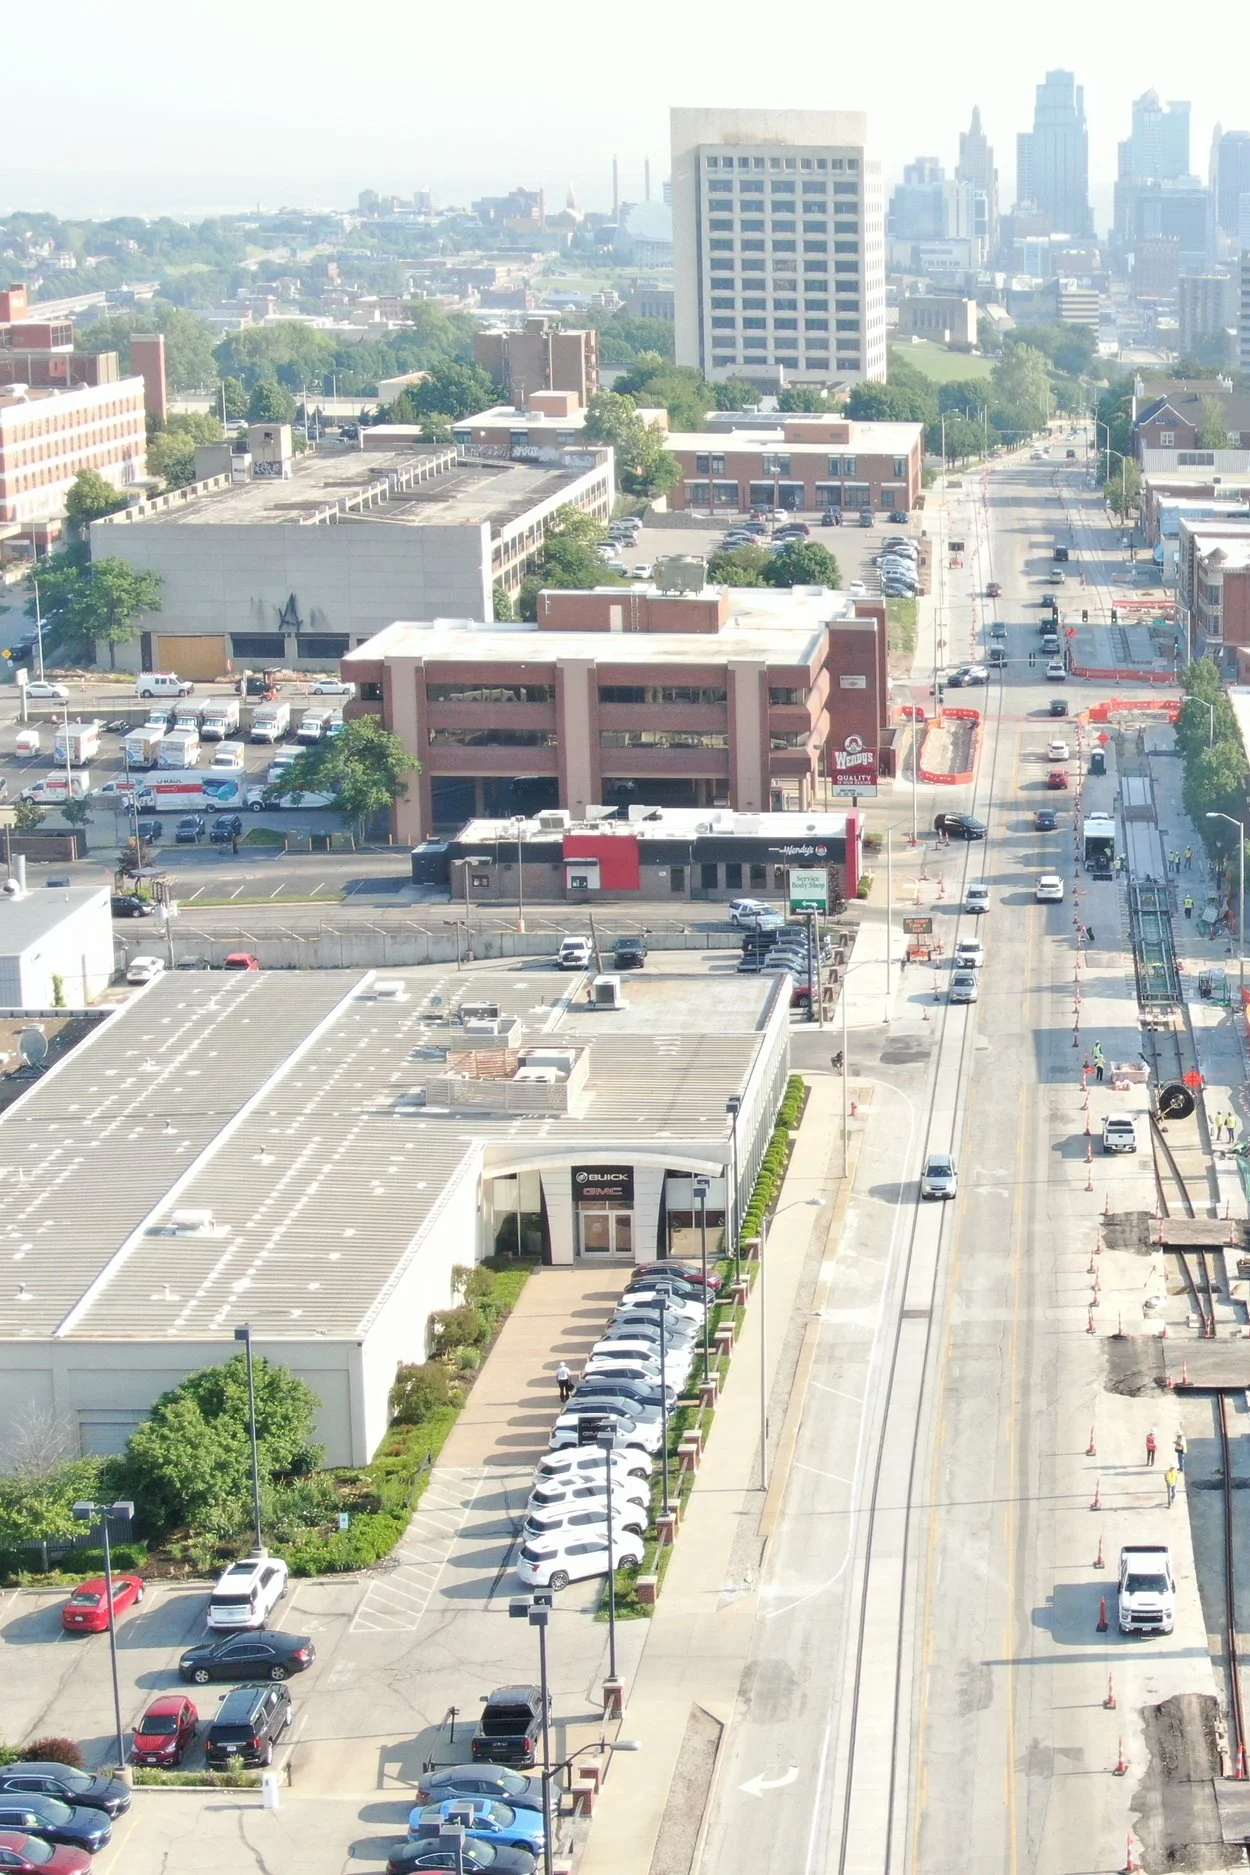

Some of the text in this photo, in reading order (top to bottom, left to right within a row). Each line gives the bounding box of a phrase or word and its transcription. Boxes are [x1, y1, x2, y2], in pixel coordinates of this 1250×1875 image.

[783, 843, 814, 857] Wendy's
[796, 874, 820, 882] Service
[791, 882, 826, 891] Body Shop
[583, 1187, 622, 1195] GMC
